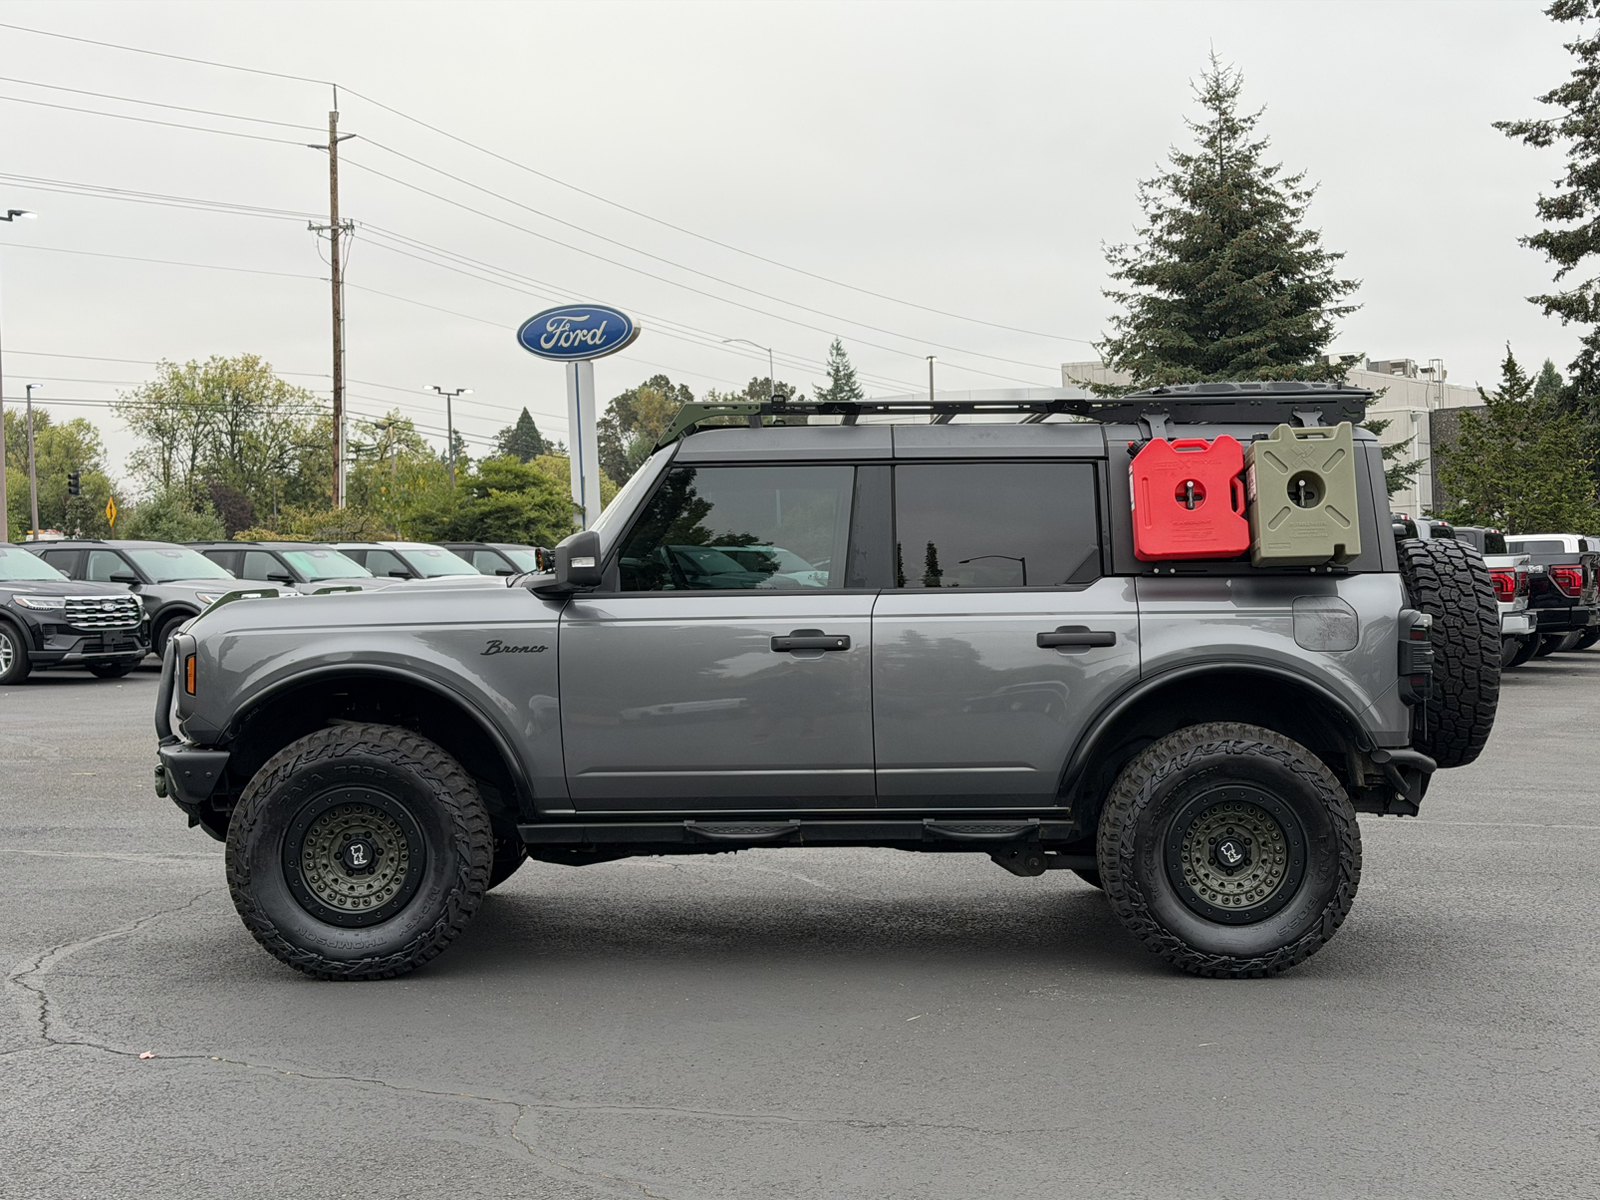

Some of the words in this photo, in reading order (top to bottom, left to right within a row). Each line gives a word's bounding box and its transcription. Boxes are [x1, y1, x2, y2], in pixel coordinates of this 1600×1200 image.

[540, 314, 608, 350] Ford
[480, 639, 549, 656] Bronco
[398, 886, 442, 937] MICKEY
[1275, 895, 1319, 937] BOSS
[294, 924, 388, 950] THOMPSON
